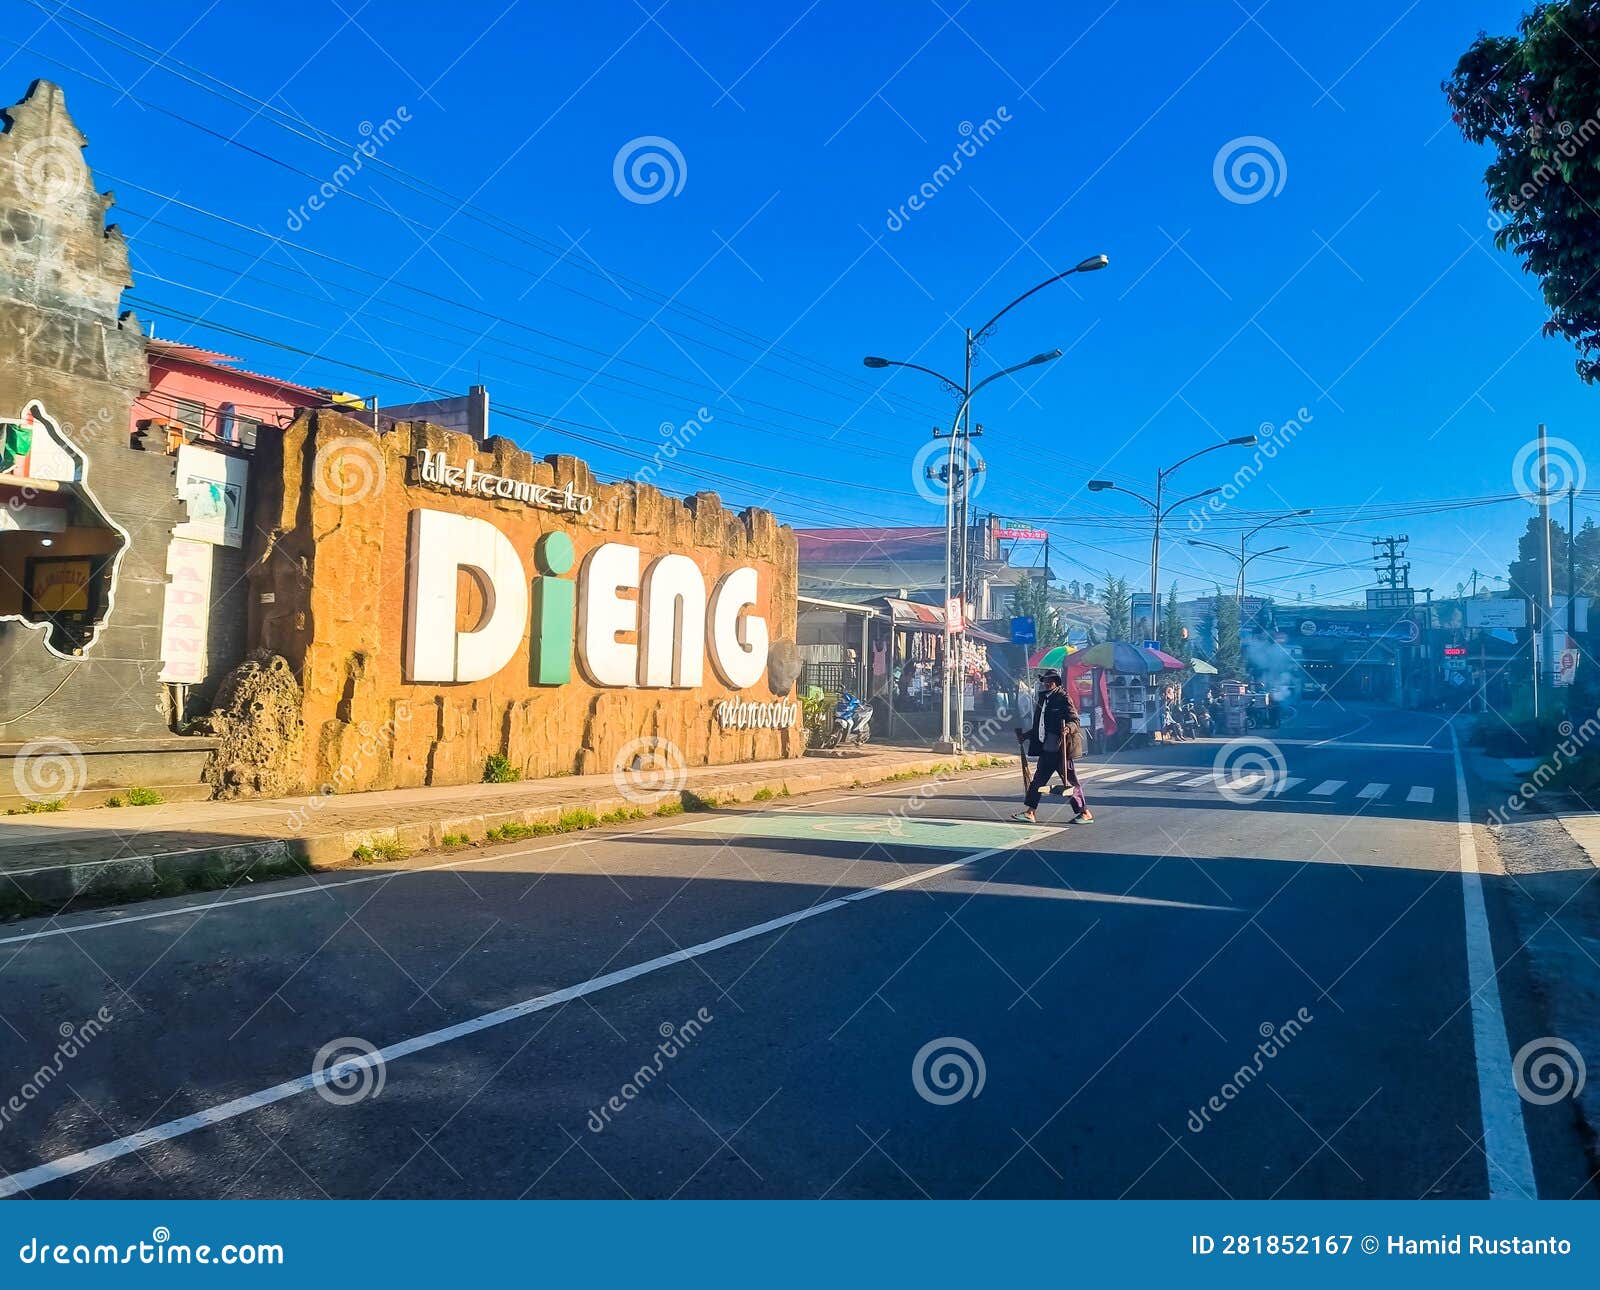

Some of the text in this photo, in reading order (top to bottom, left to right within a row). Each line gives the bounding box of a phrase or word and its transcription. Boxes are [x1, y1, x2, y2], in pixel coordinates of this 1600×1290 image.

[417, 448, 592, 516] Welcome to
[167, 543, 206, 677] PADANG
[718, 695, 797, 728] Wonosobo
